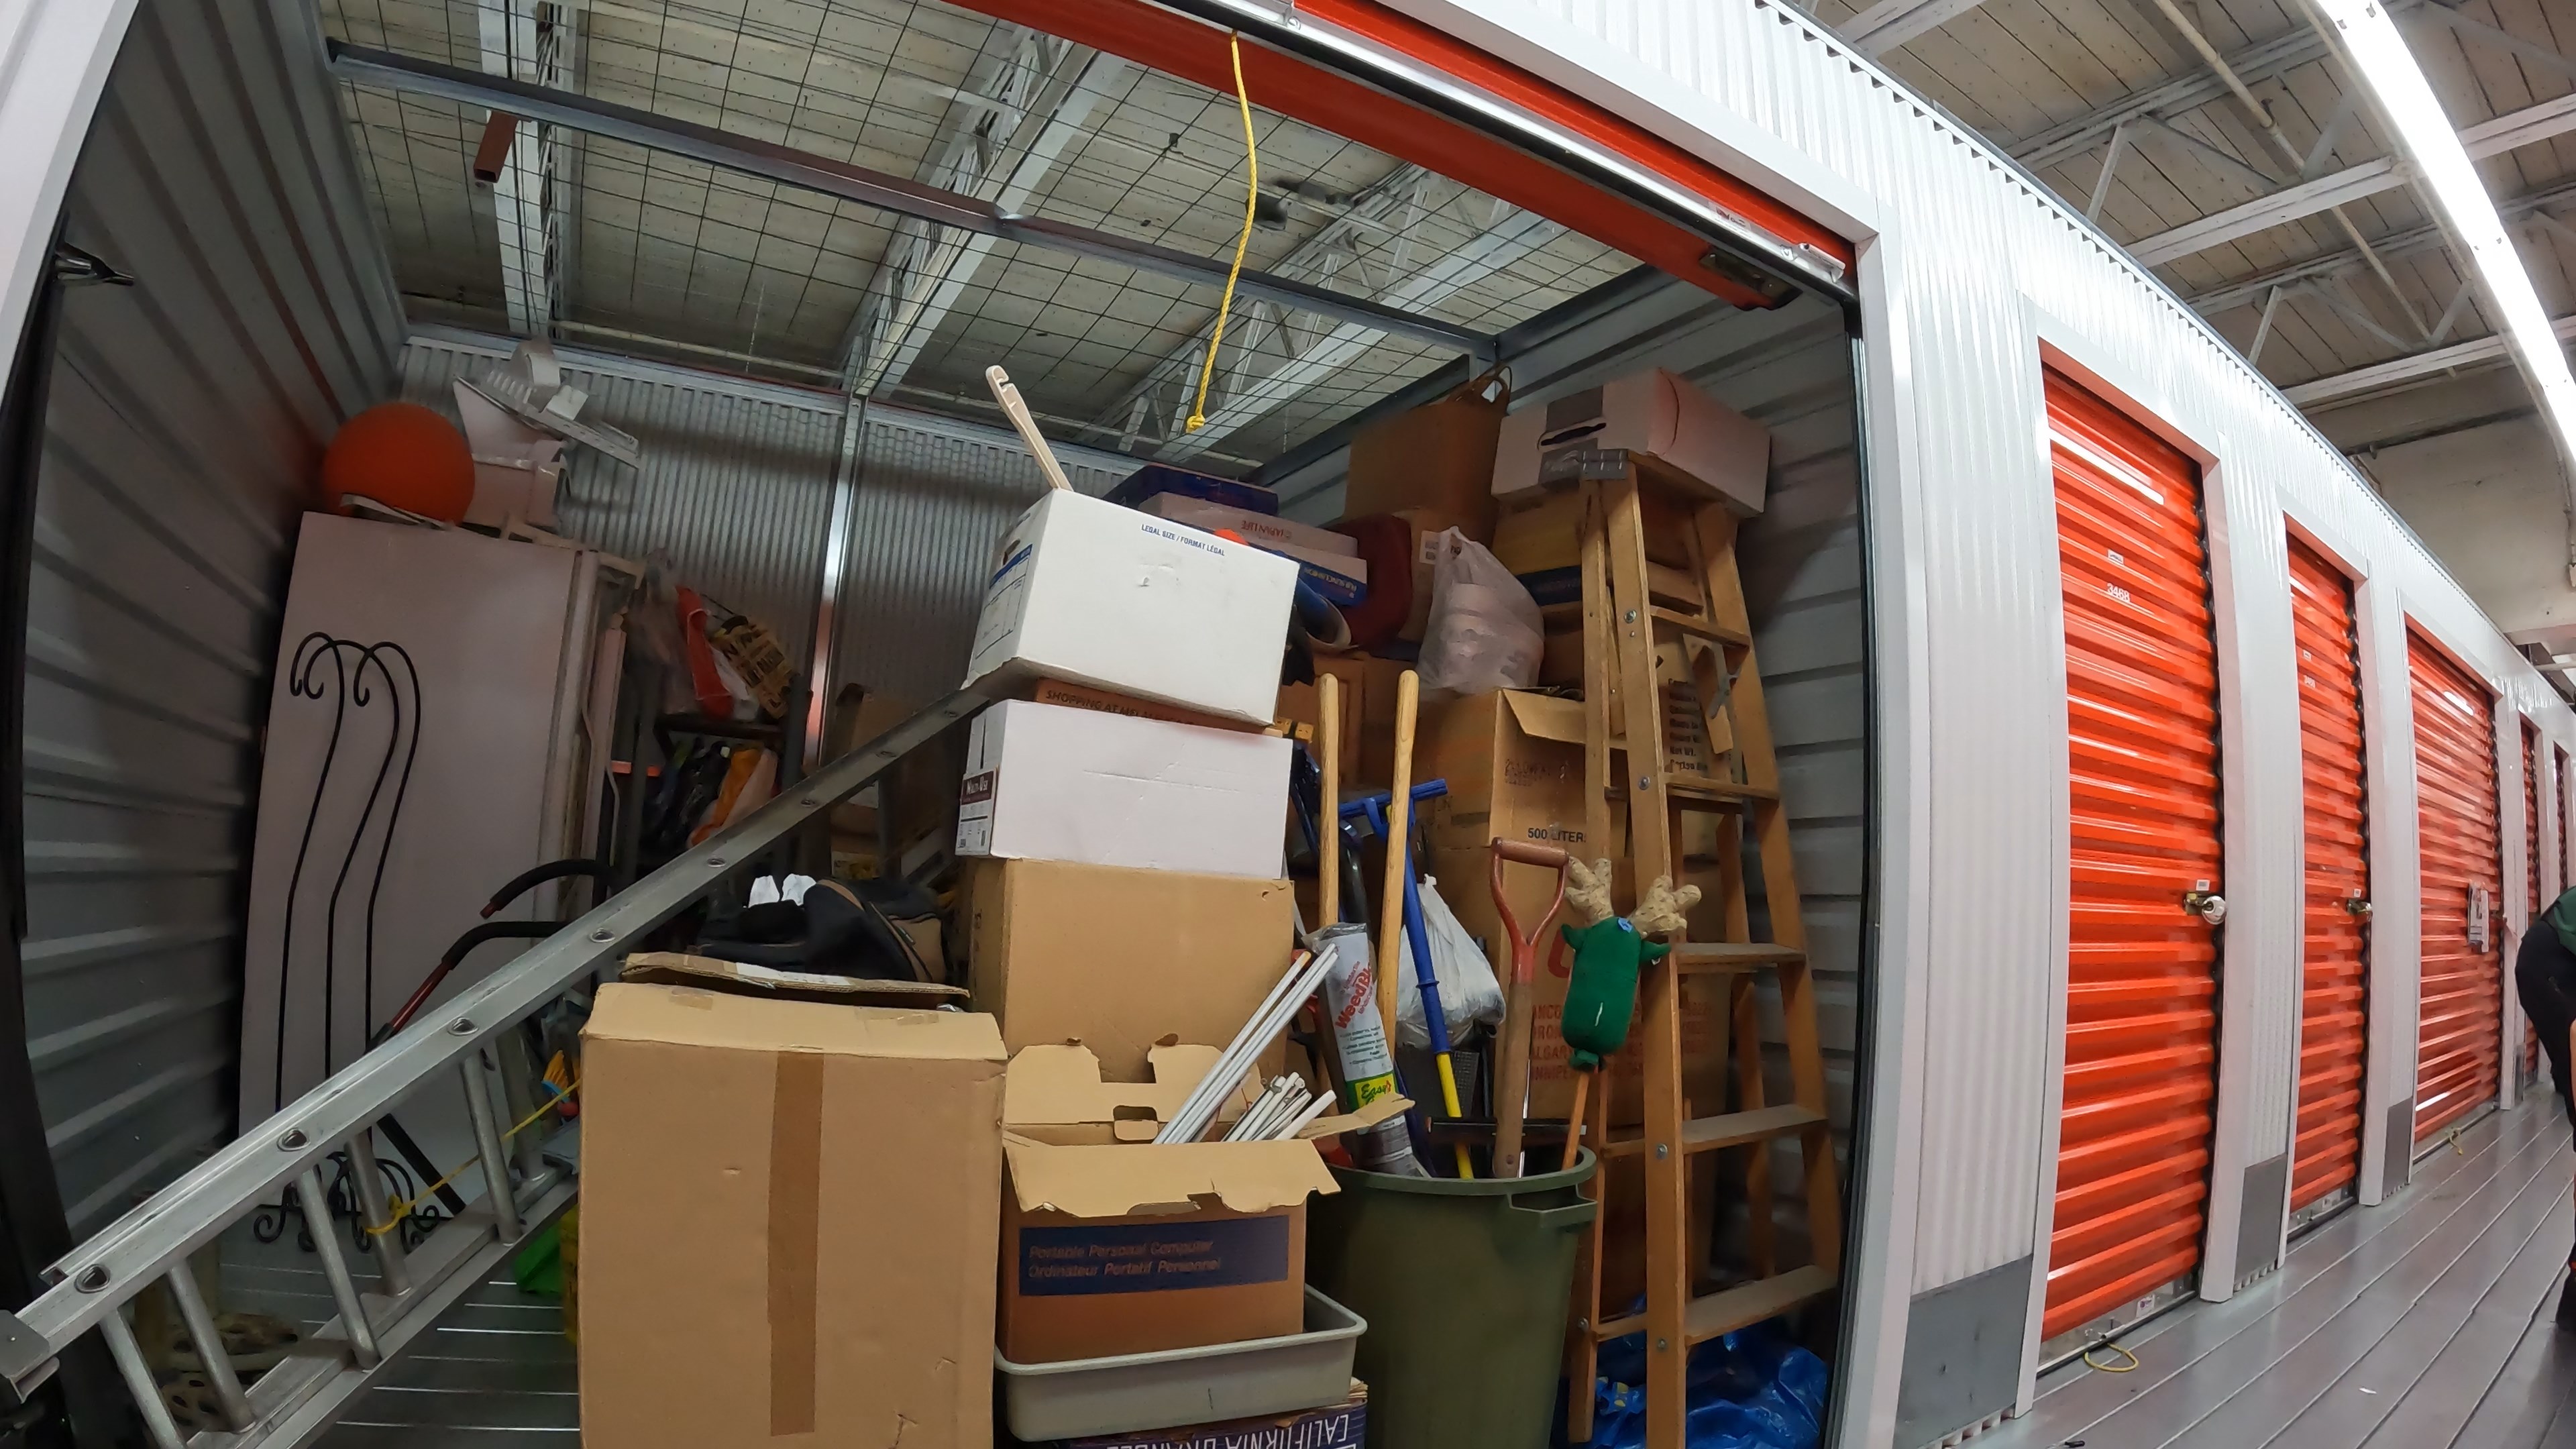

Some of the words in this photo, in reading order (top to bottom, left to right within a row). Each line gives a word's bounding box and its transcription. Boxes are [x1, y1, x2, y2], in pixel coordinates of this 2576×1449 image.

[1141, 524, 1161, 536] LEGAL
[1162, 531, 1175, 541] SIZE
[1181, 536, 1206, 550] FORMAT
[1206, 545, 1225, 557] LÉGAL
[1045, 689, 1102, 710] SHOPPING
[1527, 827, 1548, 840] 500
[1029, 1244, 1085, 1259] Portable
[1089, 1242, 1147, 1257] Personal
[1150, 1240, 1214, 1256] Computer
[1028, 1265, 1099, 1278] Ordinateur
[1104, 1260, 1153, 1275] Portatif
[1157, 1256, 1221, 1274] Personnel
